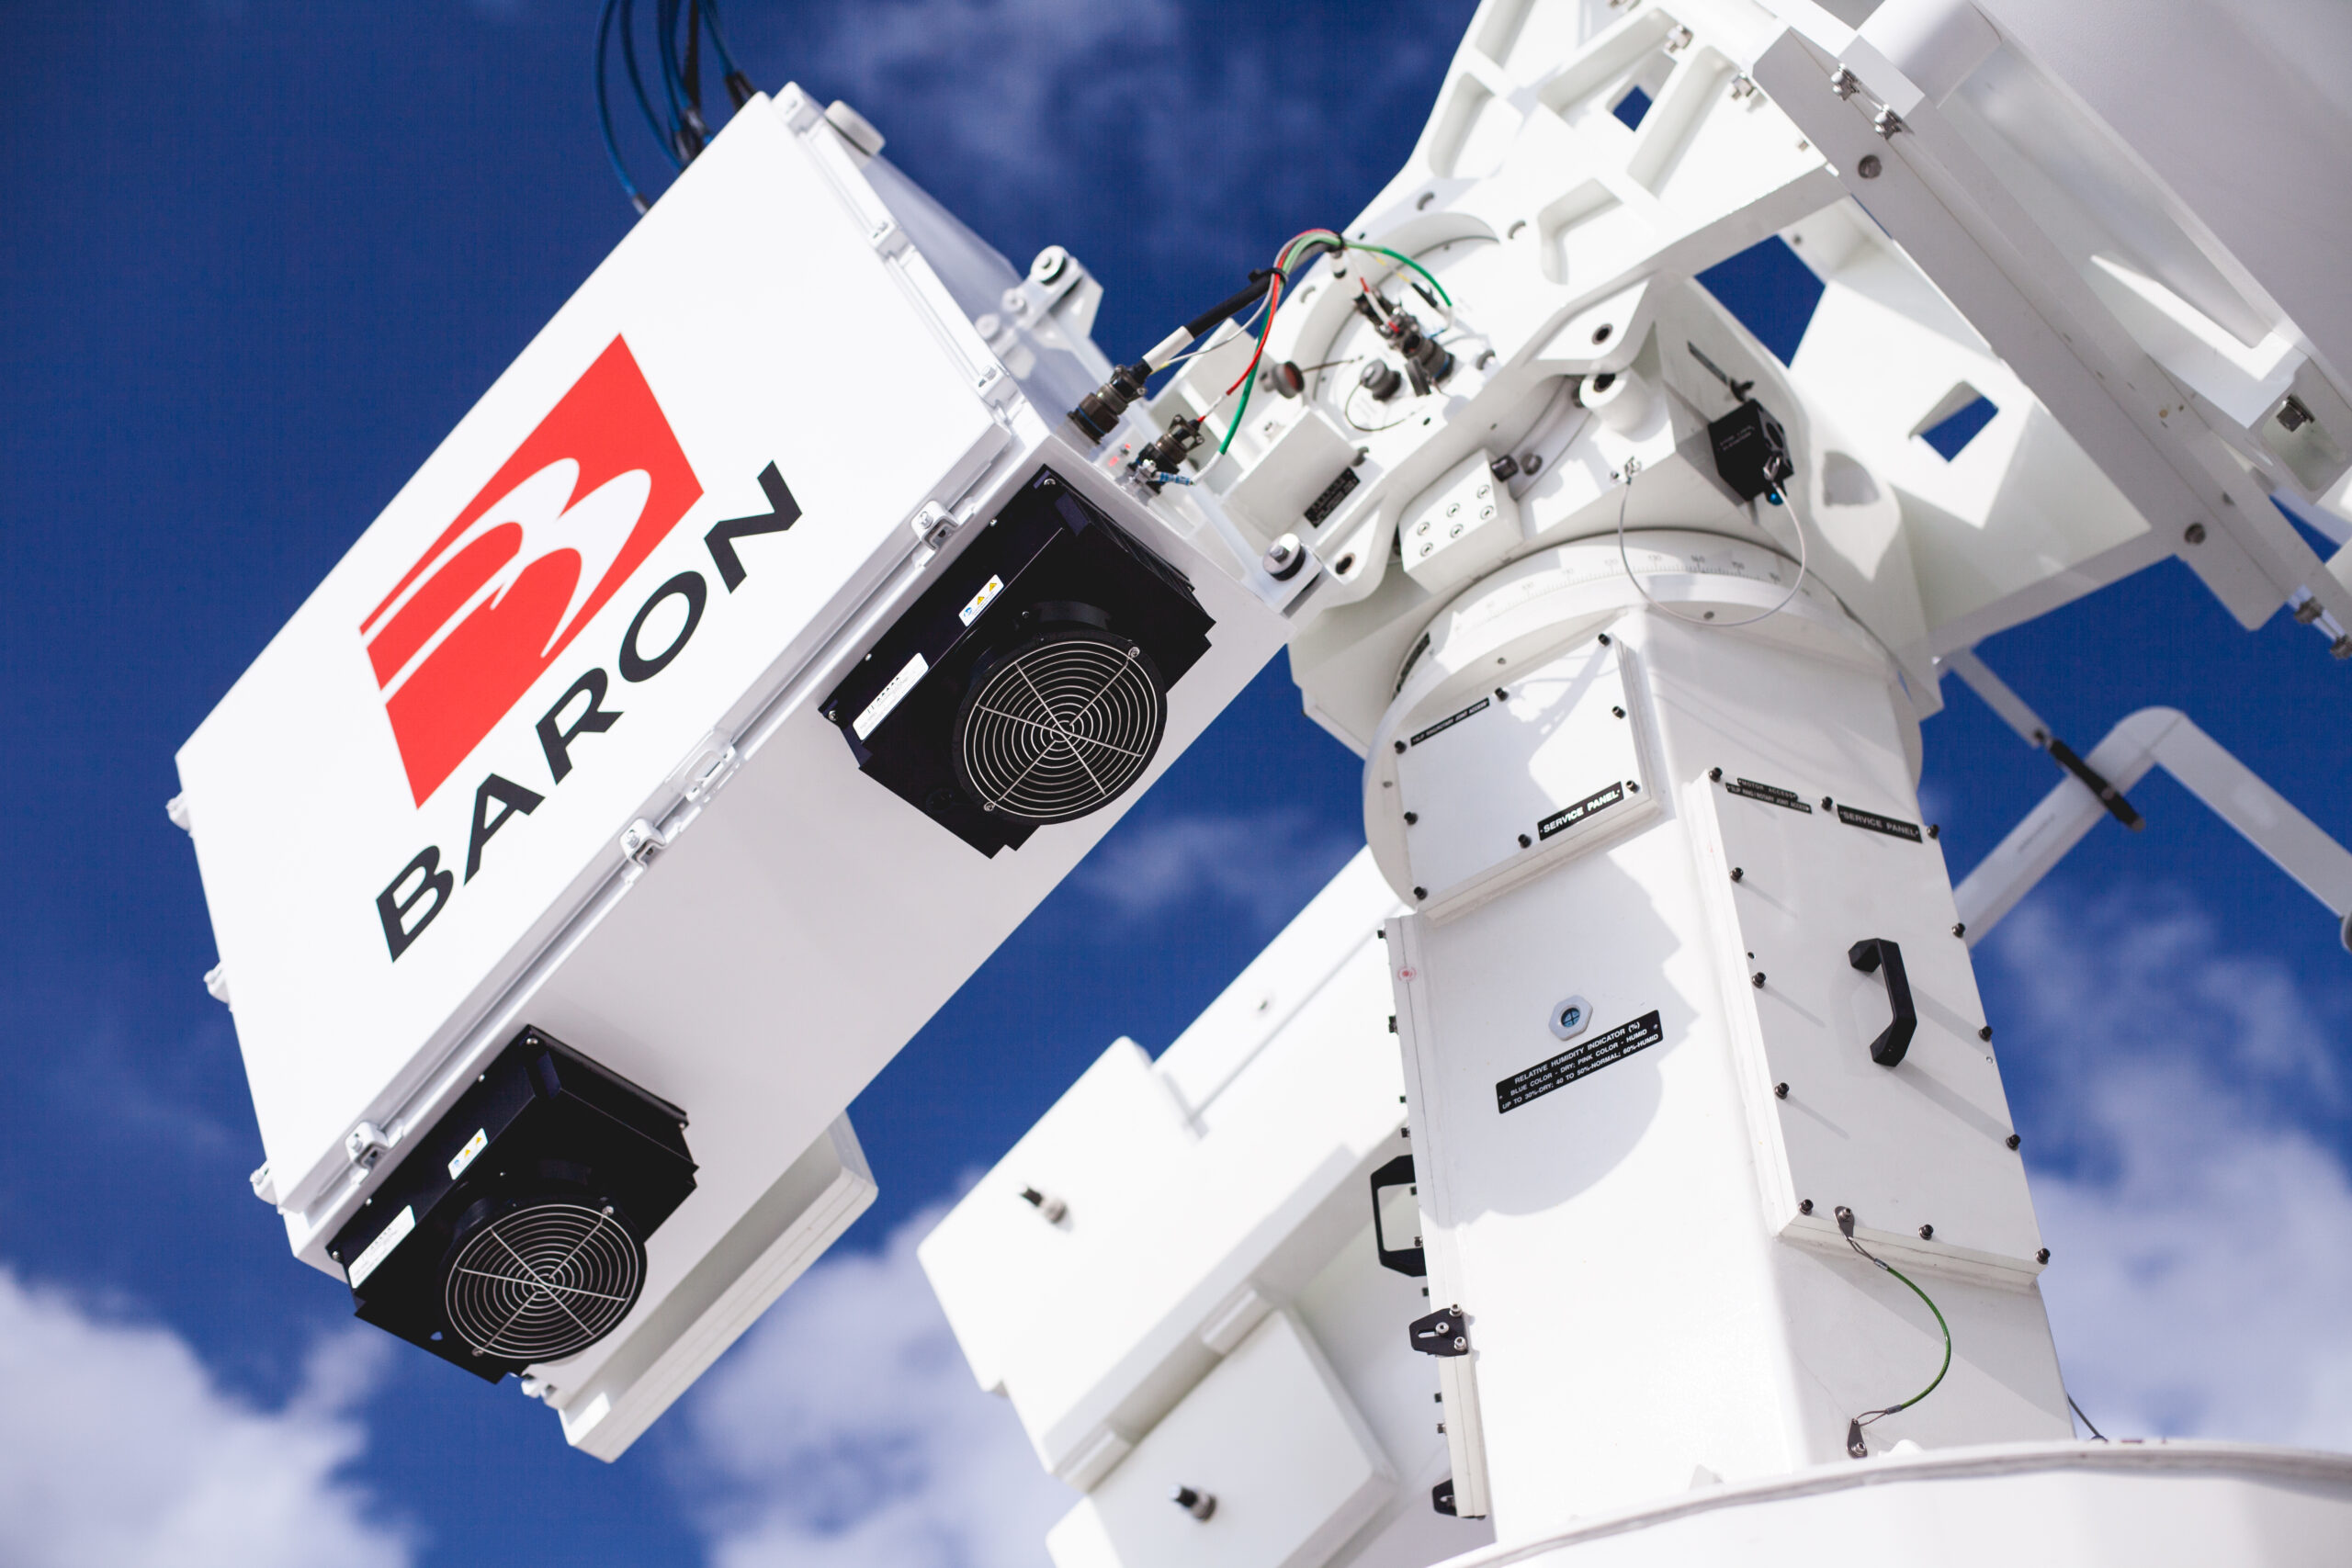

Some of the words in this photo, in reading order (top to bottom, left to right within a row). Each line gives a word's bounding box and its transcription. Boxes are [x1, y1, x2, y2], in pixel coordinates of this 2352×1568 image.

[377, 459, 802, 963] BARON
[1741, 780, 1764, 790] MOTOR
[1769, 786, 1793, 799] ACCESS
[1544, 807, 1584, 833] SERVICE
[1587, 790, 1619, 812] PANEL
[1842, 811, 1883, 829] SERVICE
[1886, 822, 1917, 838] PANEL
[1510, 1084, 1528, 1096] BLUE
[1530, 1072, 1553, 1087] COLOR
[1577, 1054, 1593, 1065] PINK
[1595, 1043, 1619, 1057] COLOR
[1625, 1029, 1647, 1043] HUMID
[1514, 1064, 1548, 1084] RELATIVE
[1551, 1047, 1584, 1067] HUMIDITY
[1588, 1028, 1625, 1051] INDICATOR
[1628, 1021, 1641, 1032] (%)
[1502, 1101, 1511, 1110] UP
[1513, 1096, 1522, 1105] TO
[1566, 1072, 1575, 1080] TO
